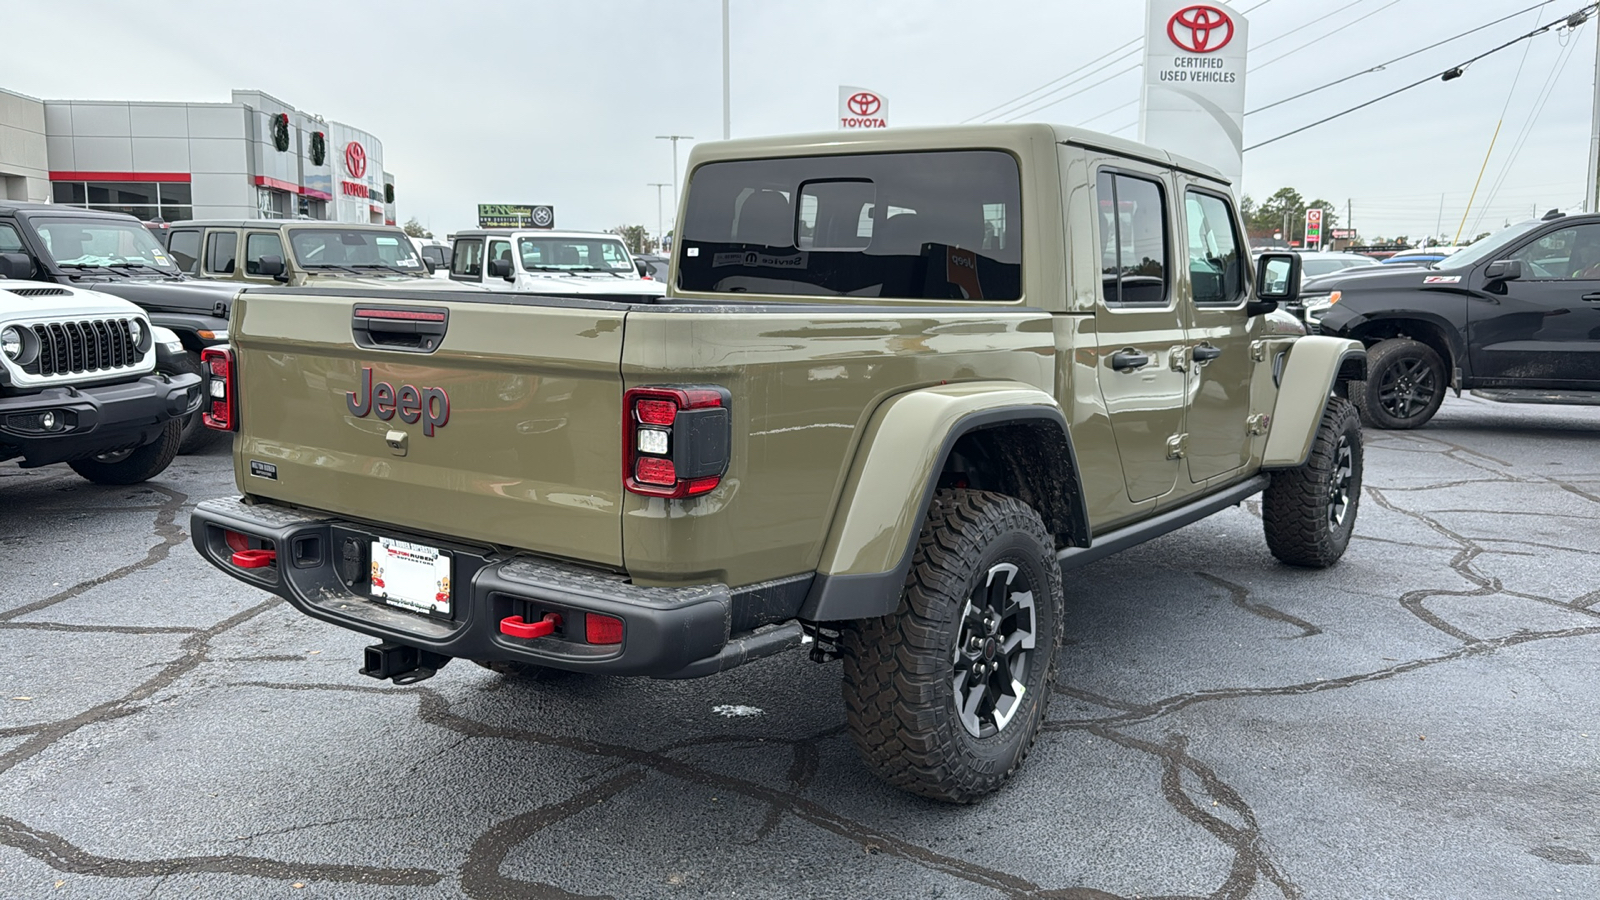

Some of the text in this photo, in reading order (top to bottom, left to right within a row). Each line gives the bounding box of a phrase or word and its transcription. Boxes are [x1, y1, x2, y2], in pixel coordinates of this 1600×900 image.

[1174, 57, 1224, 69] CERTIFIED
[1160, 70, 1236, 83] USED VEHICLES
[841, 118, 886, 128] TOYOTA
[342, 180, 369, 199] TOYOTA
[346, 367, 450, 437] Jeep
[410, 553, 434, 562] RUBEN
